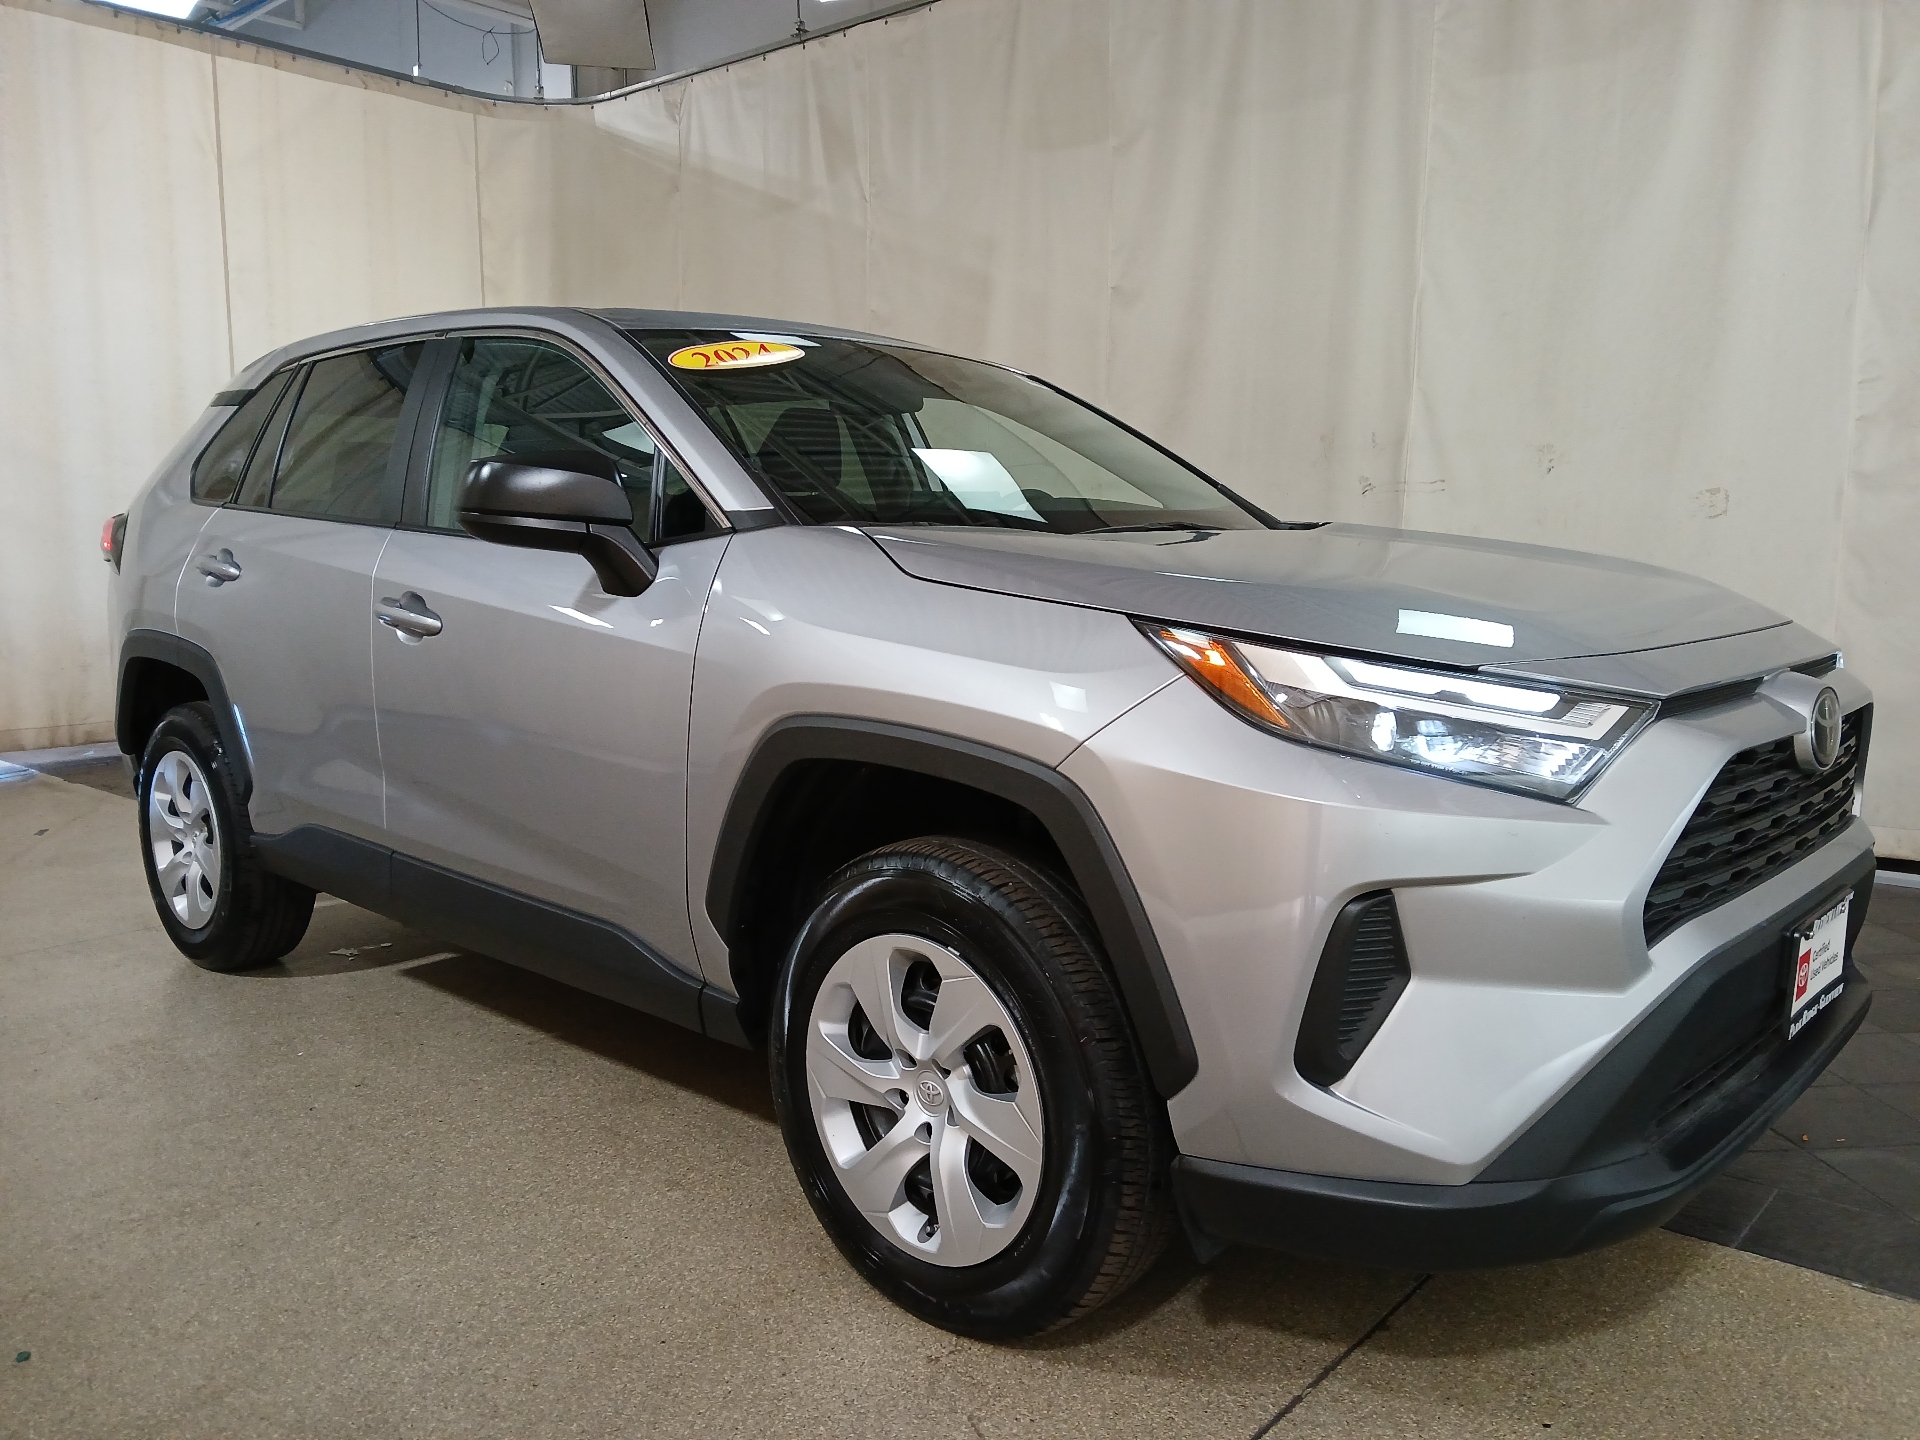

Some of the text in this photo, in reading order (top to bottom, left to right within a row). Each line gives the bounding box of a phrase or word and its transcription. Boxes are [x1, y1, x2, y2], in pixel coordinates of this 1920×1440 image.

[691, 343, 772, 367] 2024
[1812, 938, 1831, 962] Certified
[1810, 950, 1839, 980] Used Vehicles
